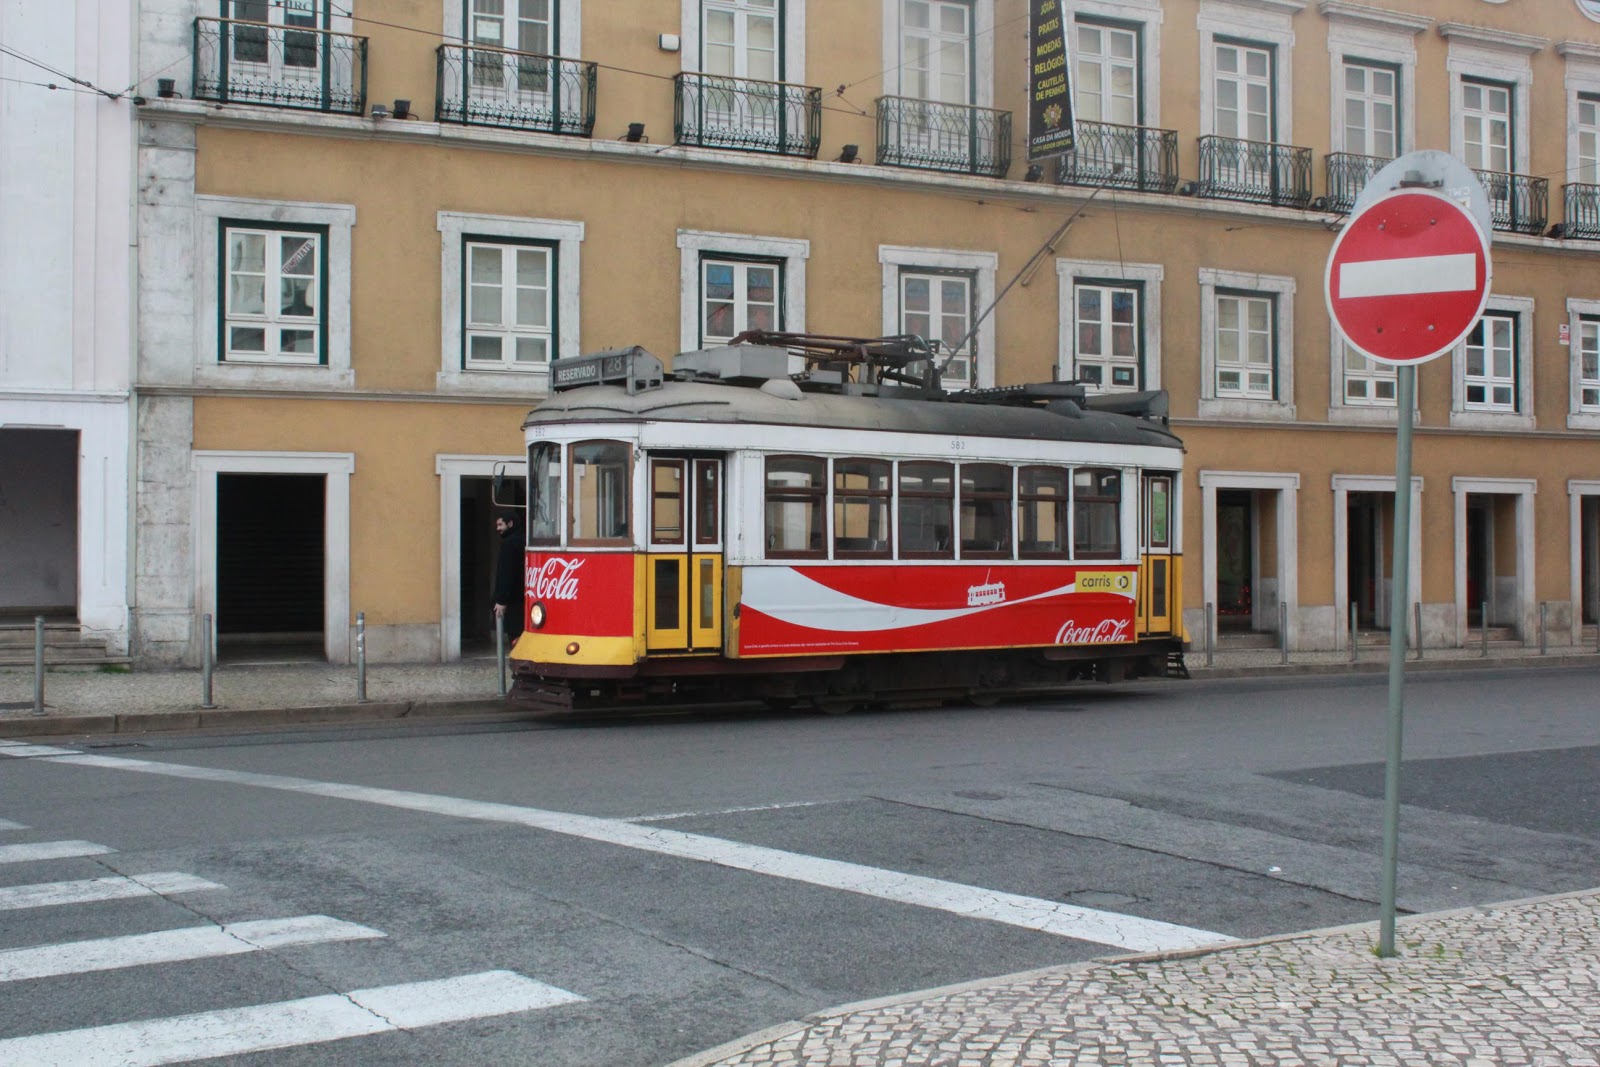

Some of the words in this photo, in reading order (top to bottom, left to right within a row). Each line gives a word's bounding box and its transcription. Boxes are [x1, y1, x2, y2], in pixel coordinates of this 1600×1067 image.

[1038, 17, 1059, 36] PRATAS
[1036, 37, 1062, 57] MOEDAS
[1035, 54, 1065, 75] RELÓGIOS
[1037, 73, 1065, 89] CAUTELAS
[1035, 91, 1045, 101] DE
[1045, 84, 1067, 98] PENHOR
[1032, 135, 1046, 145] CASA
[1046, 133, 1054, 142] DA
[1054, 129, 1072, 139] MOEDA
[557, 364, 596, 382] RESERVADO
[607, 357, 622, 372] 28
[950, 440, 966, 450] 582
[525, 556, 586, 600] ca-Cola
[1081, 574, 1111, 588] carris
